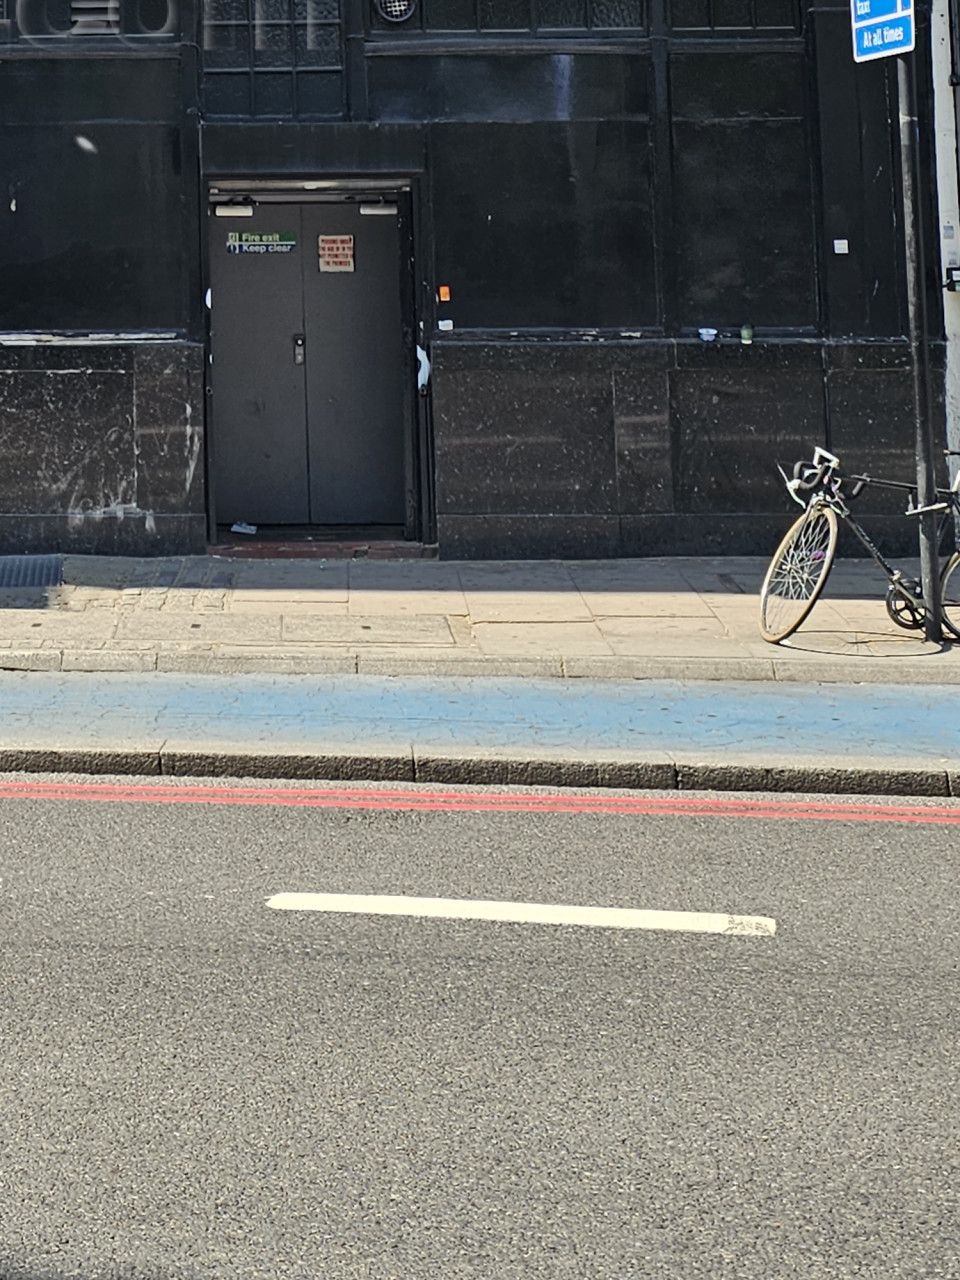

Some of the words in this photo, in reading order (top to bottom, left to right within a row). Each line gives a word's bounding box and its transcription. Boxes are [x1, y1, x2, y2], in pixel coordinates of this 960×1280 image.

[863, 31, 872, 48] At
[873, 28, 883, 46] all
[883, 26, 903, 43] times
[242, 234, 260, 242] Fire
[262, 233, 280, 241] exit
[242, 245, 266, 254] Keep
[268, 244, 291, 252] clear
